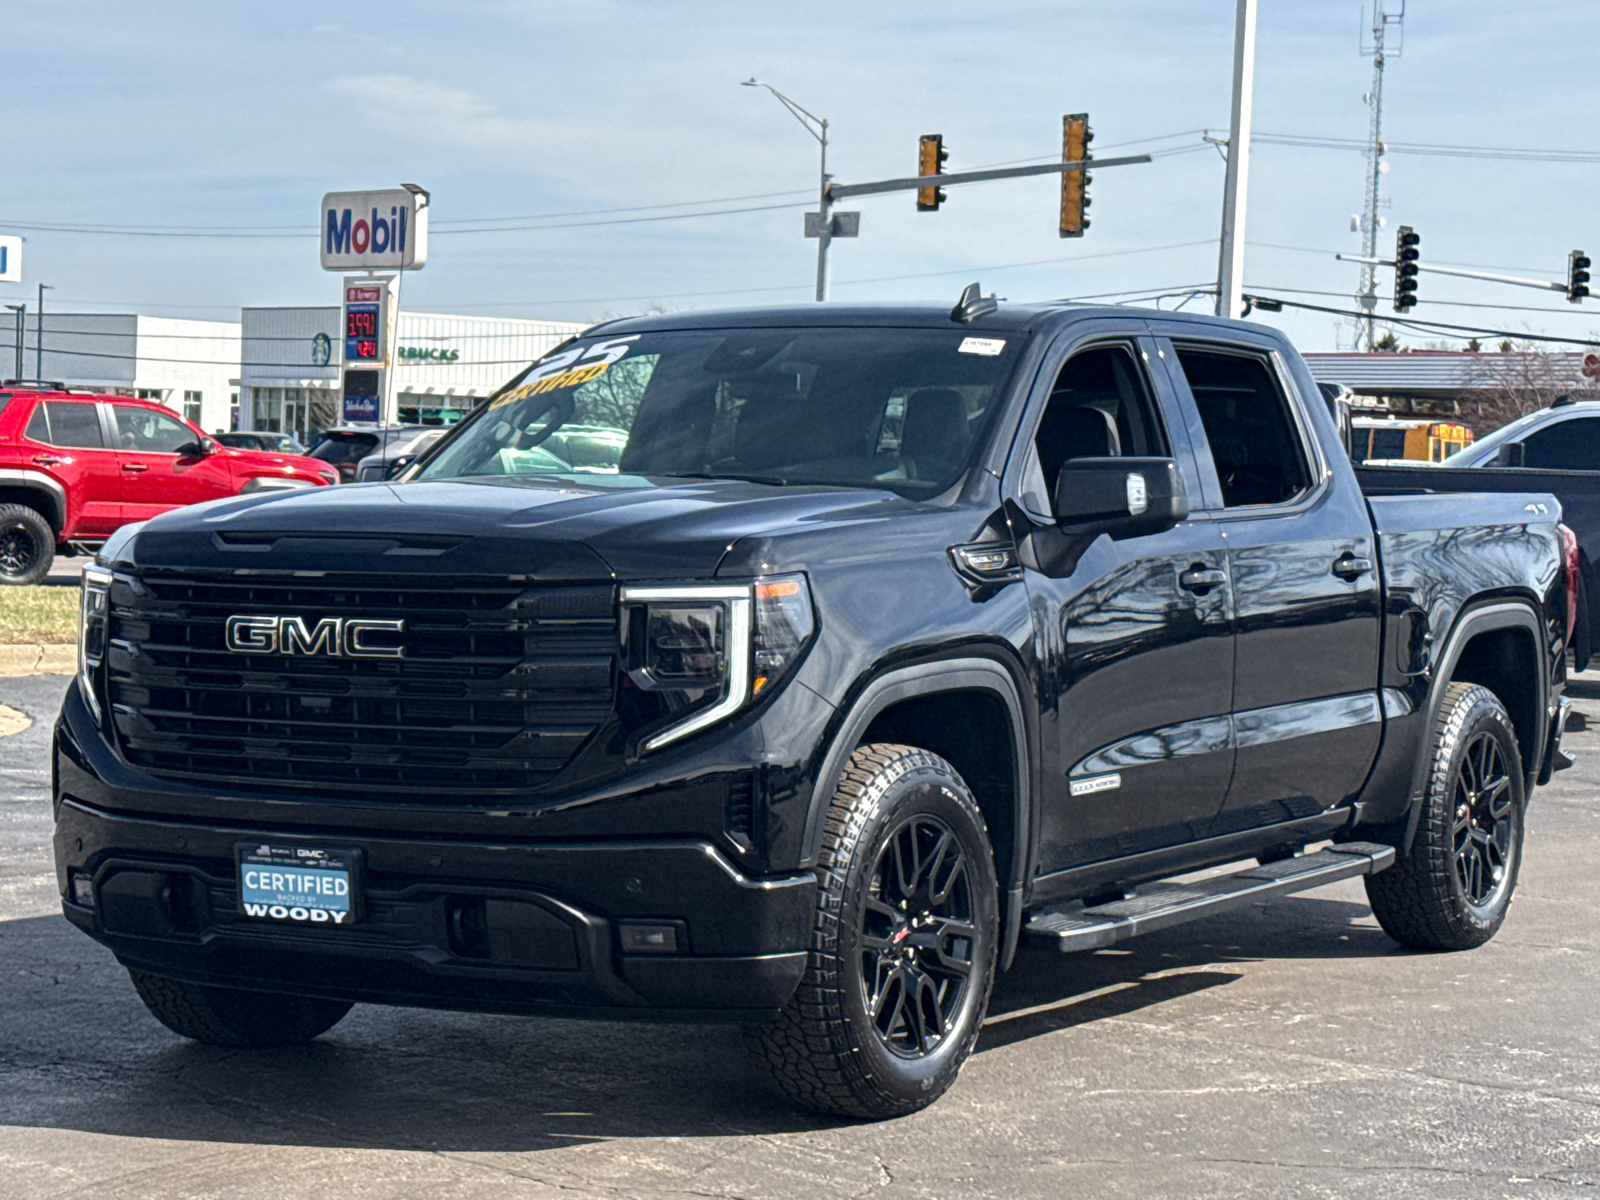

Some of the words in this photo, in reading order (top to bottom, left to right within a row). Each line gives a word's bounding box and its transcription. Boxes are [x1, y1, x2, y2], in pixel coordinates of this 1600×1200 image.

[326, 206, 405, 254] Mobil
[398, 346, 459, 361] RBUCKS
[520, 334, 641, 387] 25
[488, 363, 609, 411] CERTIFIED
[225, 615, 404, 658] GMC
[297, 849, 325, 858] GMC
[245, 871, 349, 896] CERTIFIED
[277, 893, 305, 903] BACKED
[243, 903, 347, 924] WOODY
